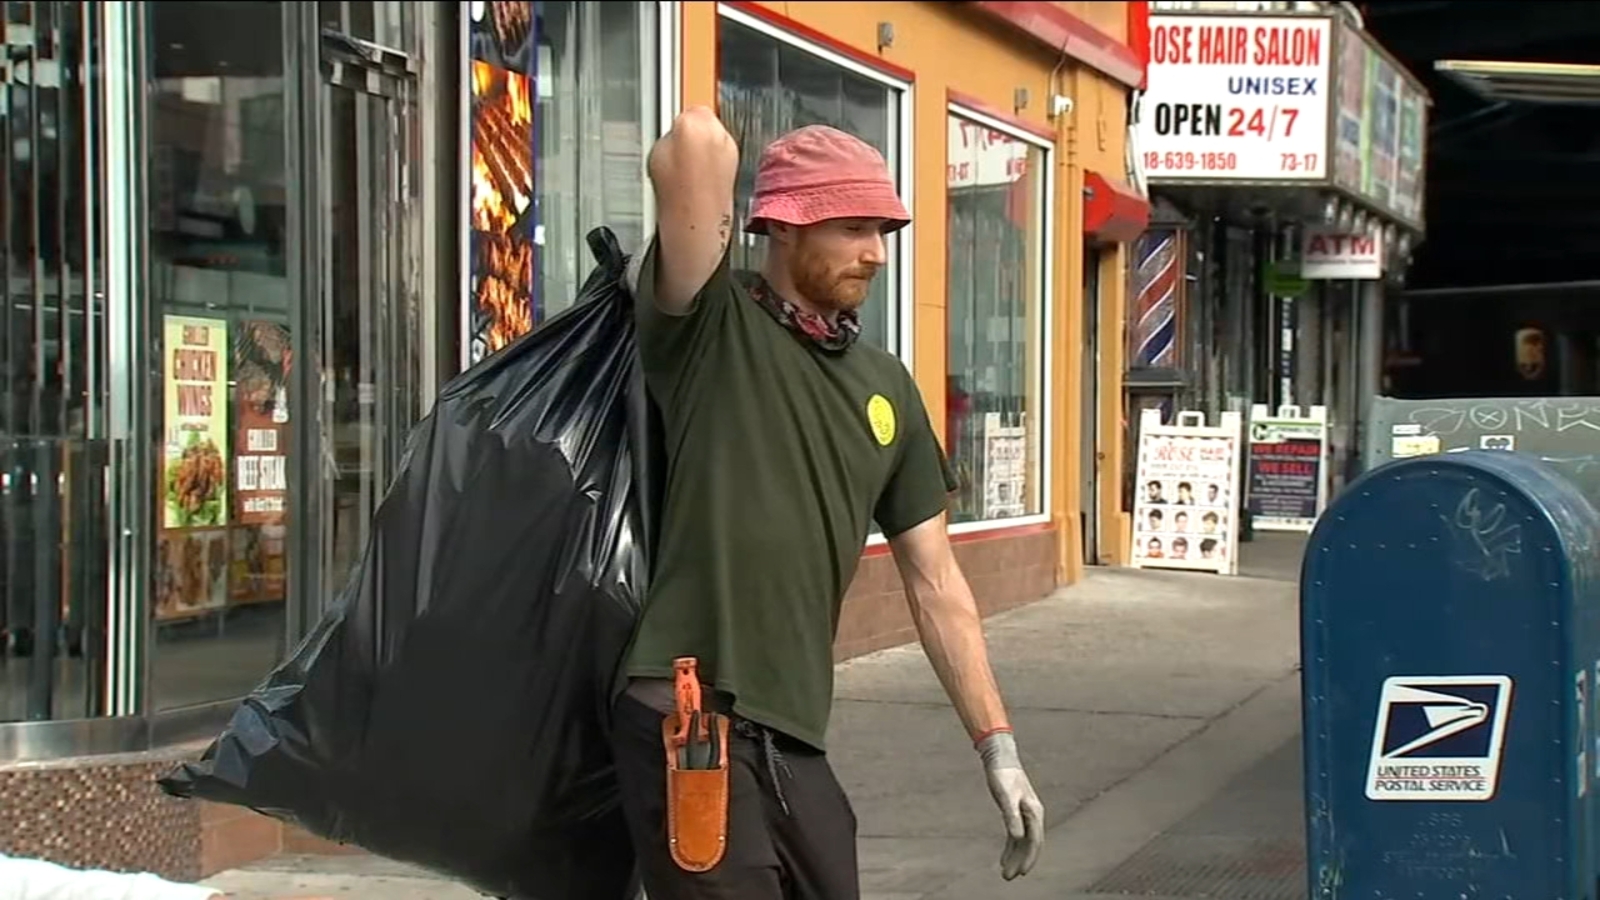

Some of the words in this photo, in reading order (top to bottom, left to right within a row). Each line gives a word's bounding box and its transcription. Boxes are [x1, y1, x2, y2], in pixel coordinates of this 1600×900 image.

[1149, 25, 1192, 64] OSE
[1198, 26, 1248, 64] HAIR
[1253, 27, 1320, 66] SALON
[1228, 76, 1317, 96] UNISEX
[1155, 102, 1221, 136] OPEN
[1227, 105, 1299, 142] 24/7
[1280, 153, 1318, 171] 73-17
[1306, 233, 1375, 256] ATM
[173, 348, 217, 381] CHICKEN
[177, 384, 212, 416] WINGS
[1377, 765, 1430, 777] UNITED
[1432, 765, 1481, 777] STATES
[1375, 779, 1426, 791] POSTAL
[1428, 779, 1487, 791] SERVICE
